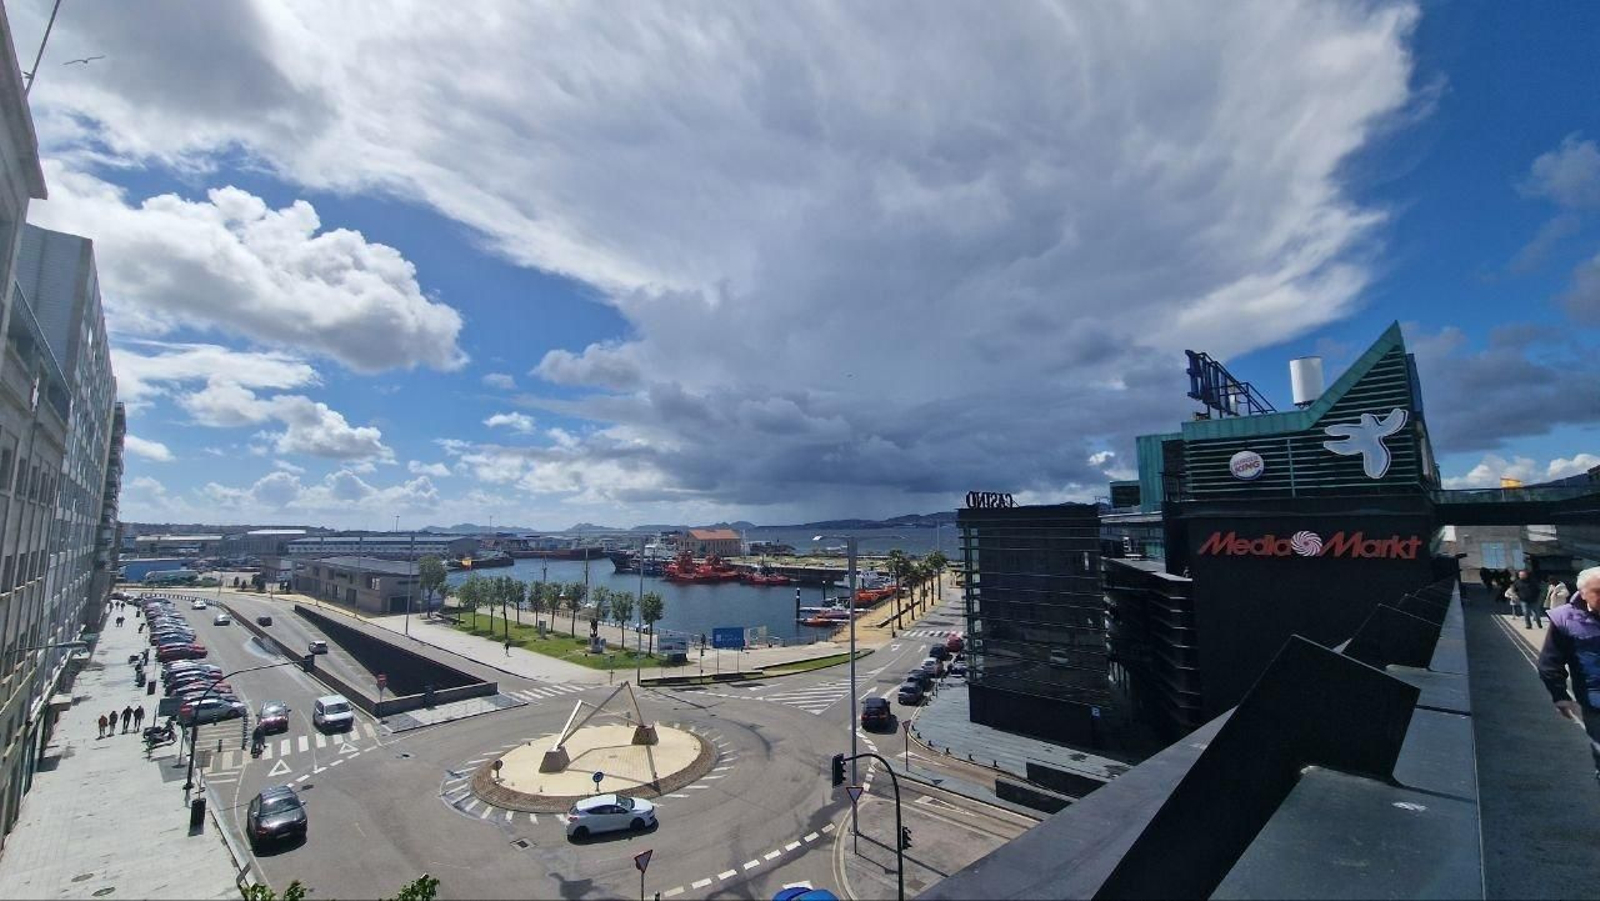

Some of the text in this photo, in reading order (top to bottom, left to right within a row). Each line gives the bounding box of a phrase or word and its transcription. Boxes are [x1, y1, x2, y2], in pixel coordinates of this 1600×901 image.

[1234, 460, 1260, 473] KING
[1199, 531, 1422, 559] Media Markt
